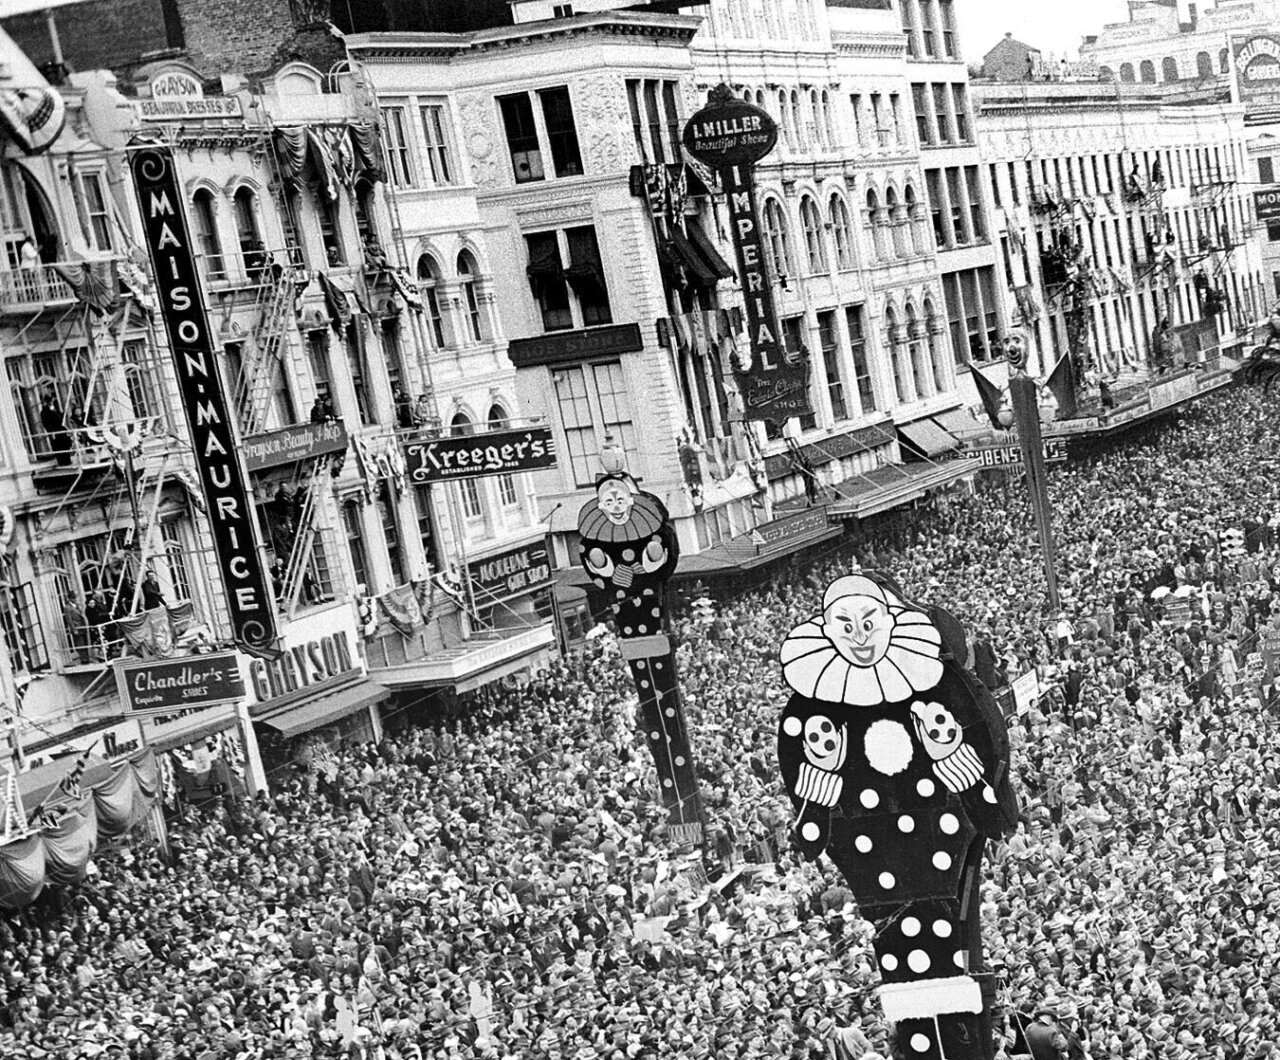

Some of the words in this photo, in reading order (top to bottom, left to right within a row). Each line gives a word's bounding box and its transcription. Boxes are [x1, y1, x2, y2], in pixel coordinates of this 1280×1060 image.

[154, 75, 199, 97] GRAYSON
[731, 165, 778, 371] IMPERIAL
[242, 438, 280, 464] Grayson
[281, 429, 314, 453] Beauty
[314, 420, 341, 443] Shop
[407, 432, 546, 481] Kreeger's
[440, 465, 483, 475] ESTABLISHED
[480, 550, 531, 584] MODERNE
[134, 666, 223, 692] Chandler's
[249, 630, 353, 703] GRAYSON
[181, 685, 210, 699] SHOES
